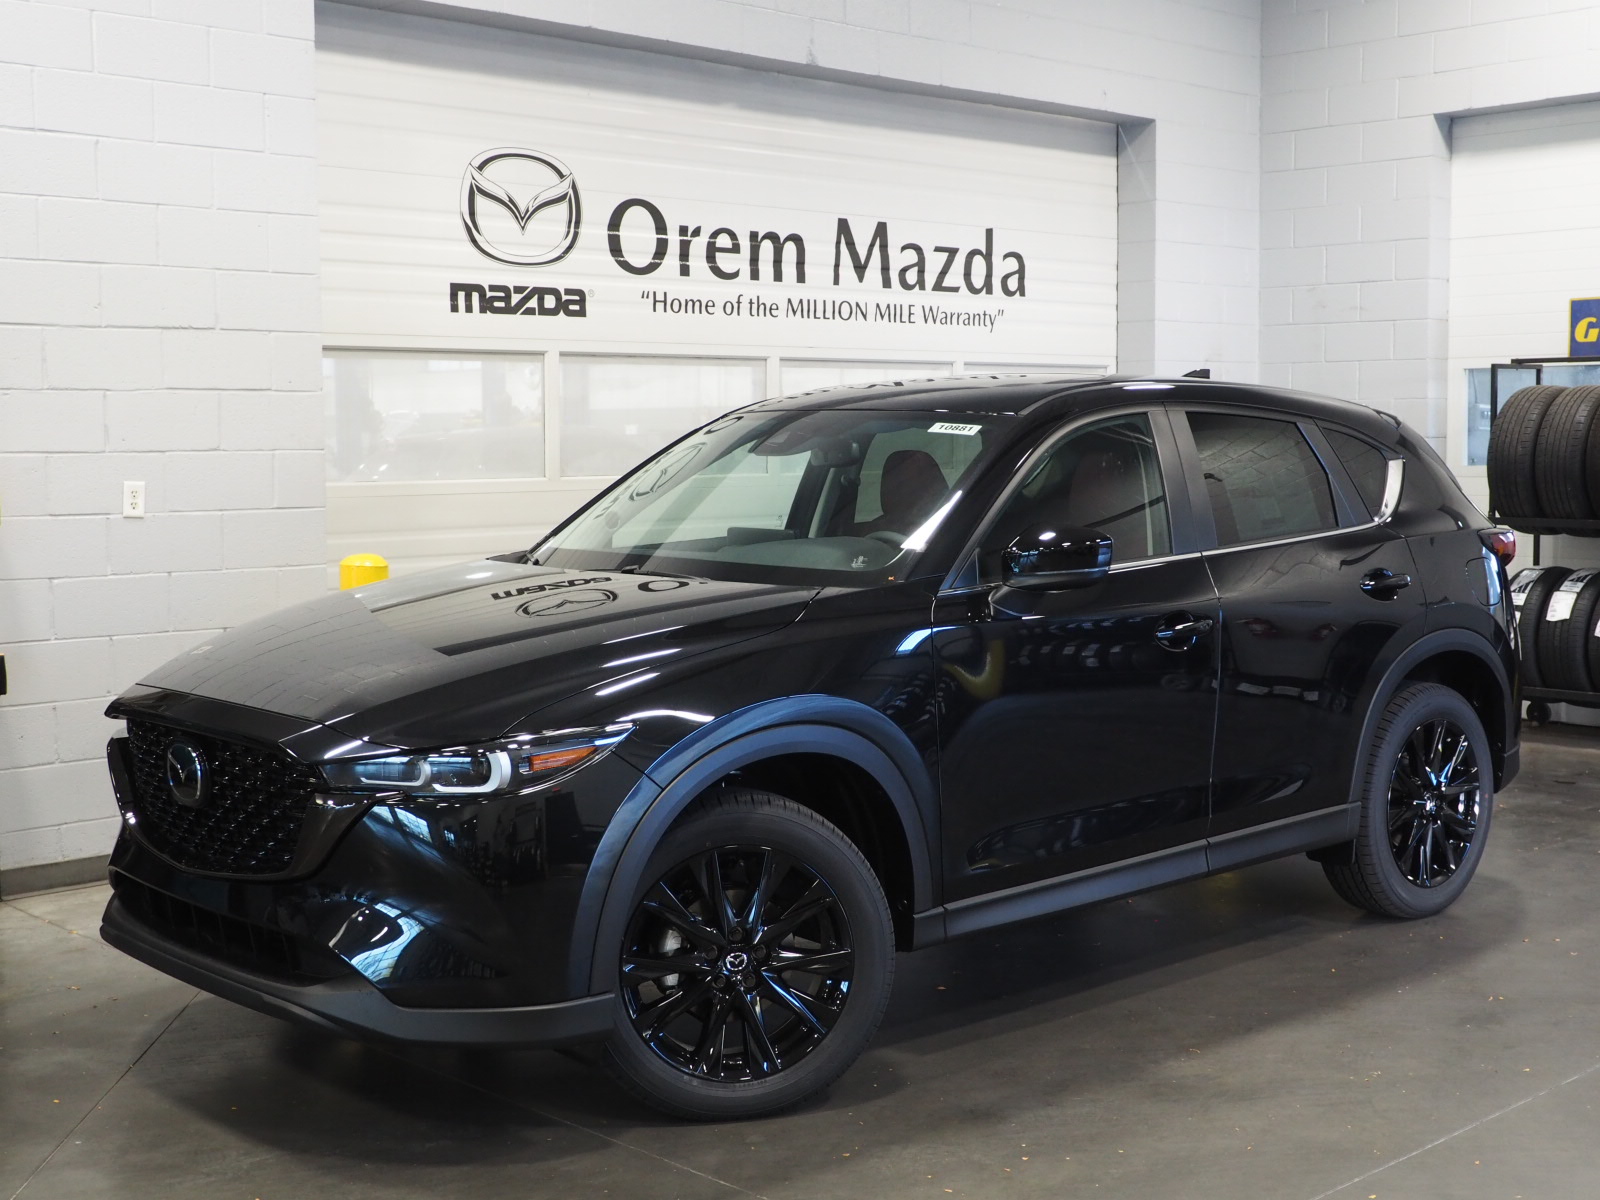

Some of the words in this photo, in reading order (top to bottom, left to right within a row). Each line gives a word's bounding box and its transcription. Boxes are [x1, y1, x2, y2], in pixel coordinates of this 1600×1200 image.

[607, 197, 806, 284] Orem
[833, 217, 1026, 298] Mazda
[722, 294, 744, 317] of
[748, 295, 780, 318] the
[786, 297, 868, 322] MILLION
[874, 302, 916, 324] MILE
[938, 423, 974, 432] 10881
